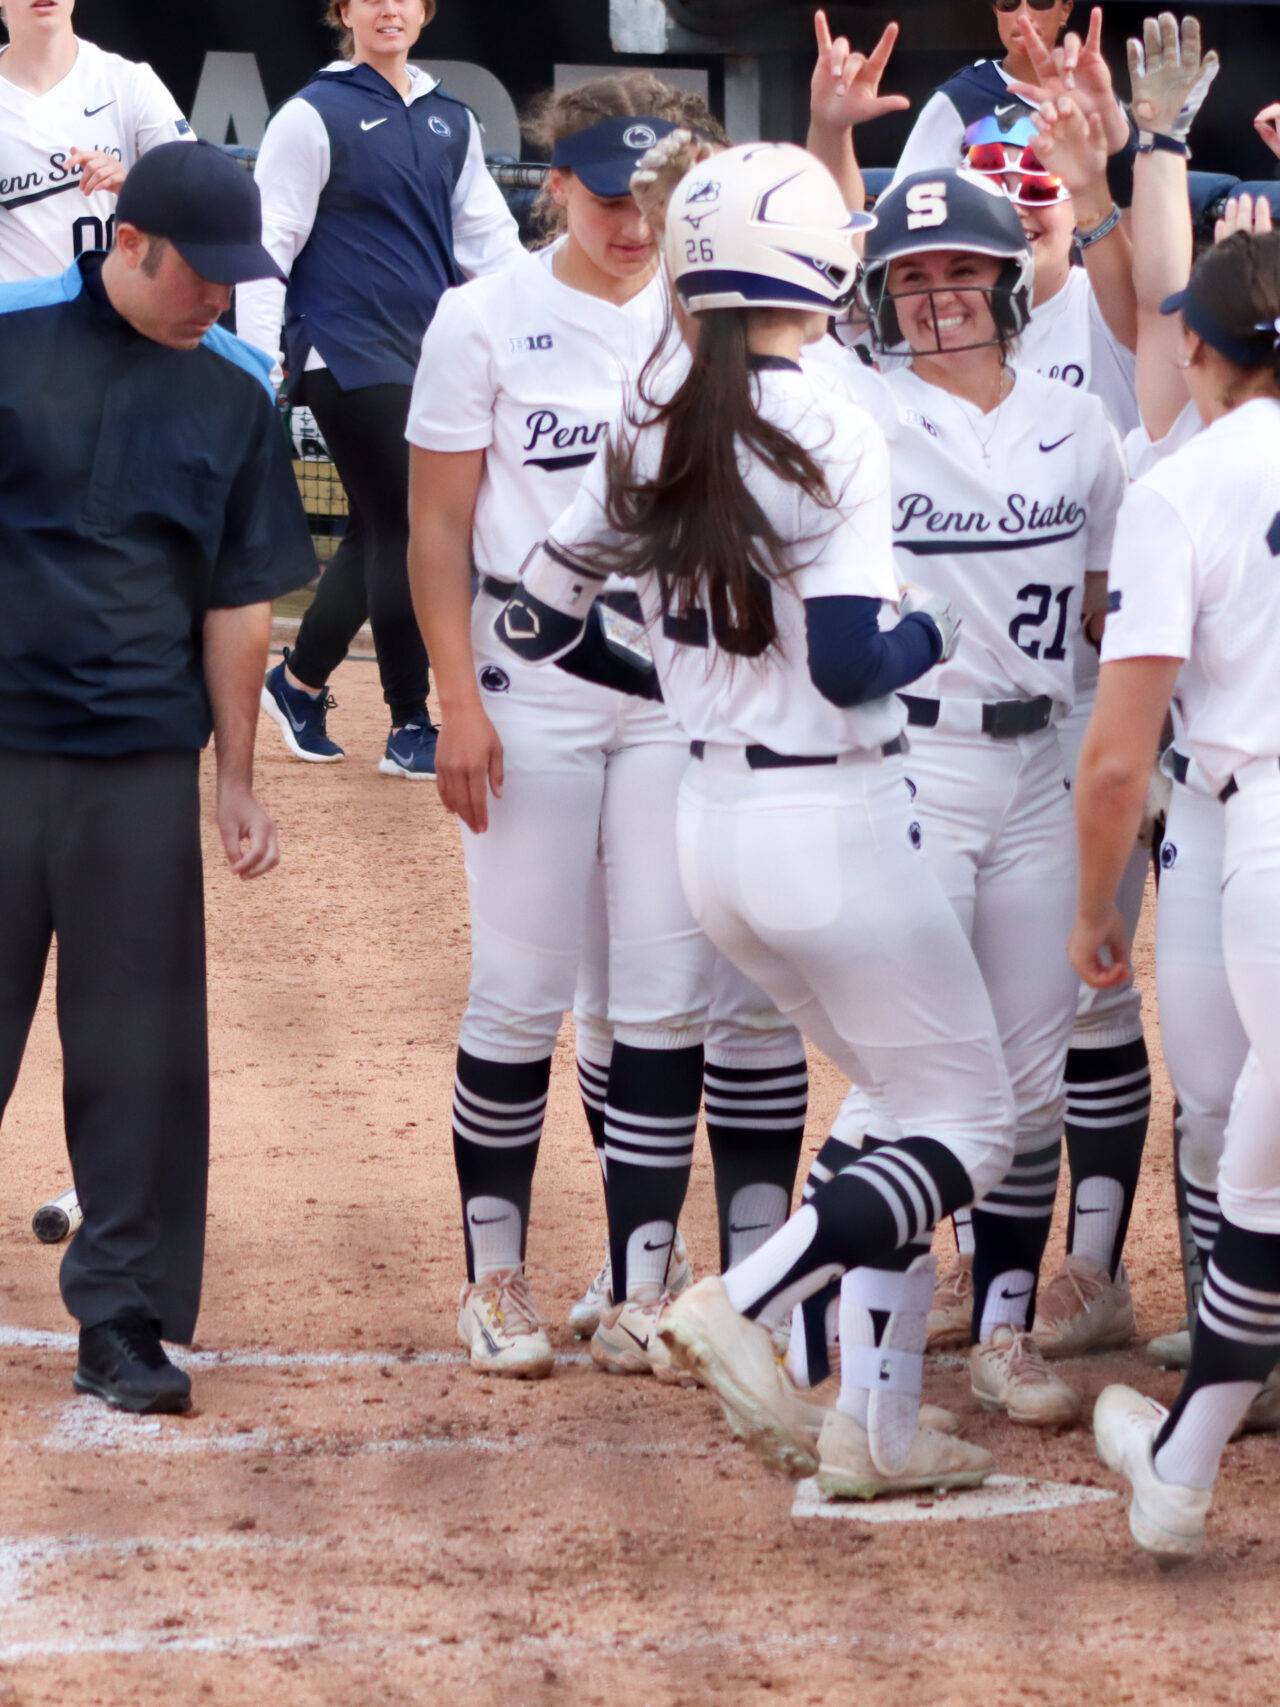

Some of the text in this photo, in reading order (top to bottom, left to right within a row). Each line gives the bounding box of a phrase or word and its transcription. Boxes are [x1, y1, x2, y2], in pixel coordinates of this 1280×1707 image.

[0, 171, 43, 195] enn
[685, 238, 714, 263] 26
[892, 493, 1087, 534] Penn State
[1008, 583, 1076, 662] 21
